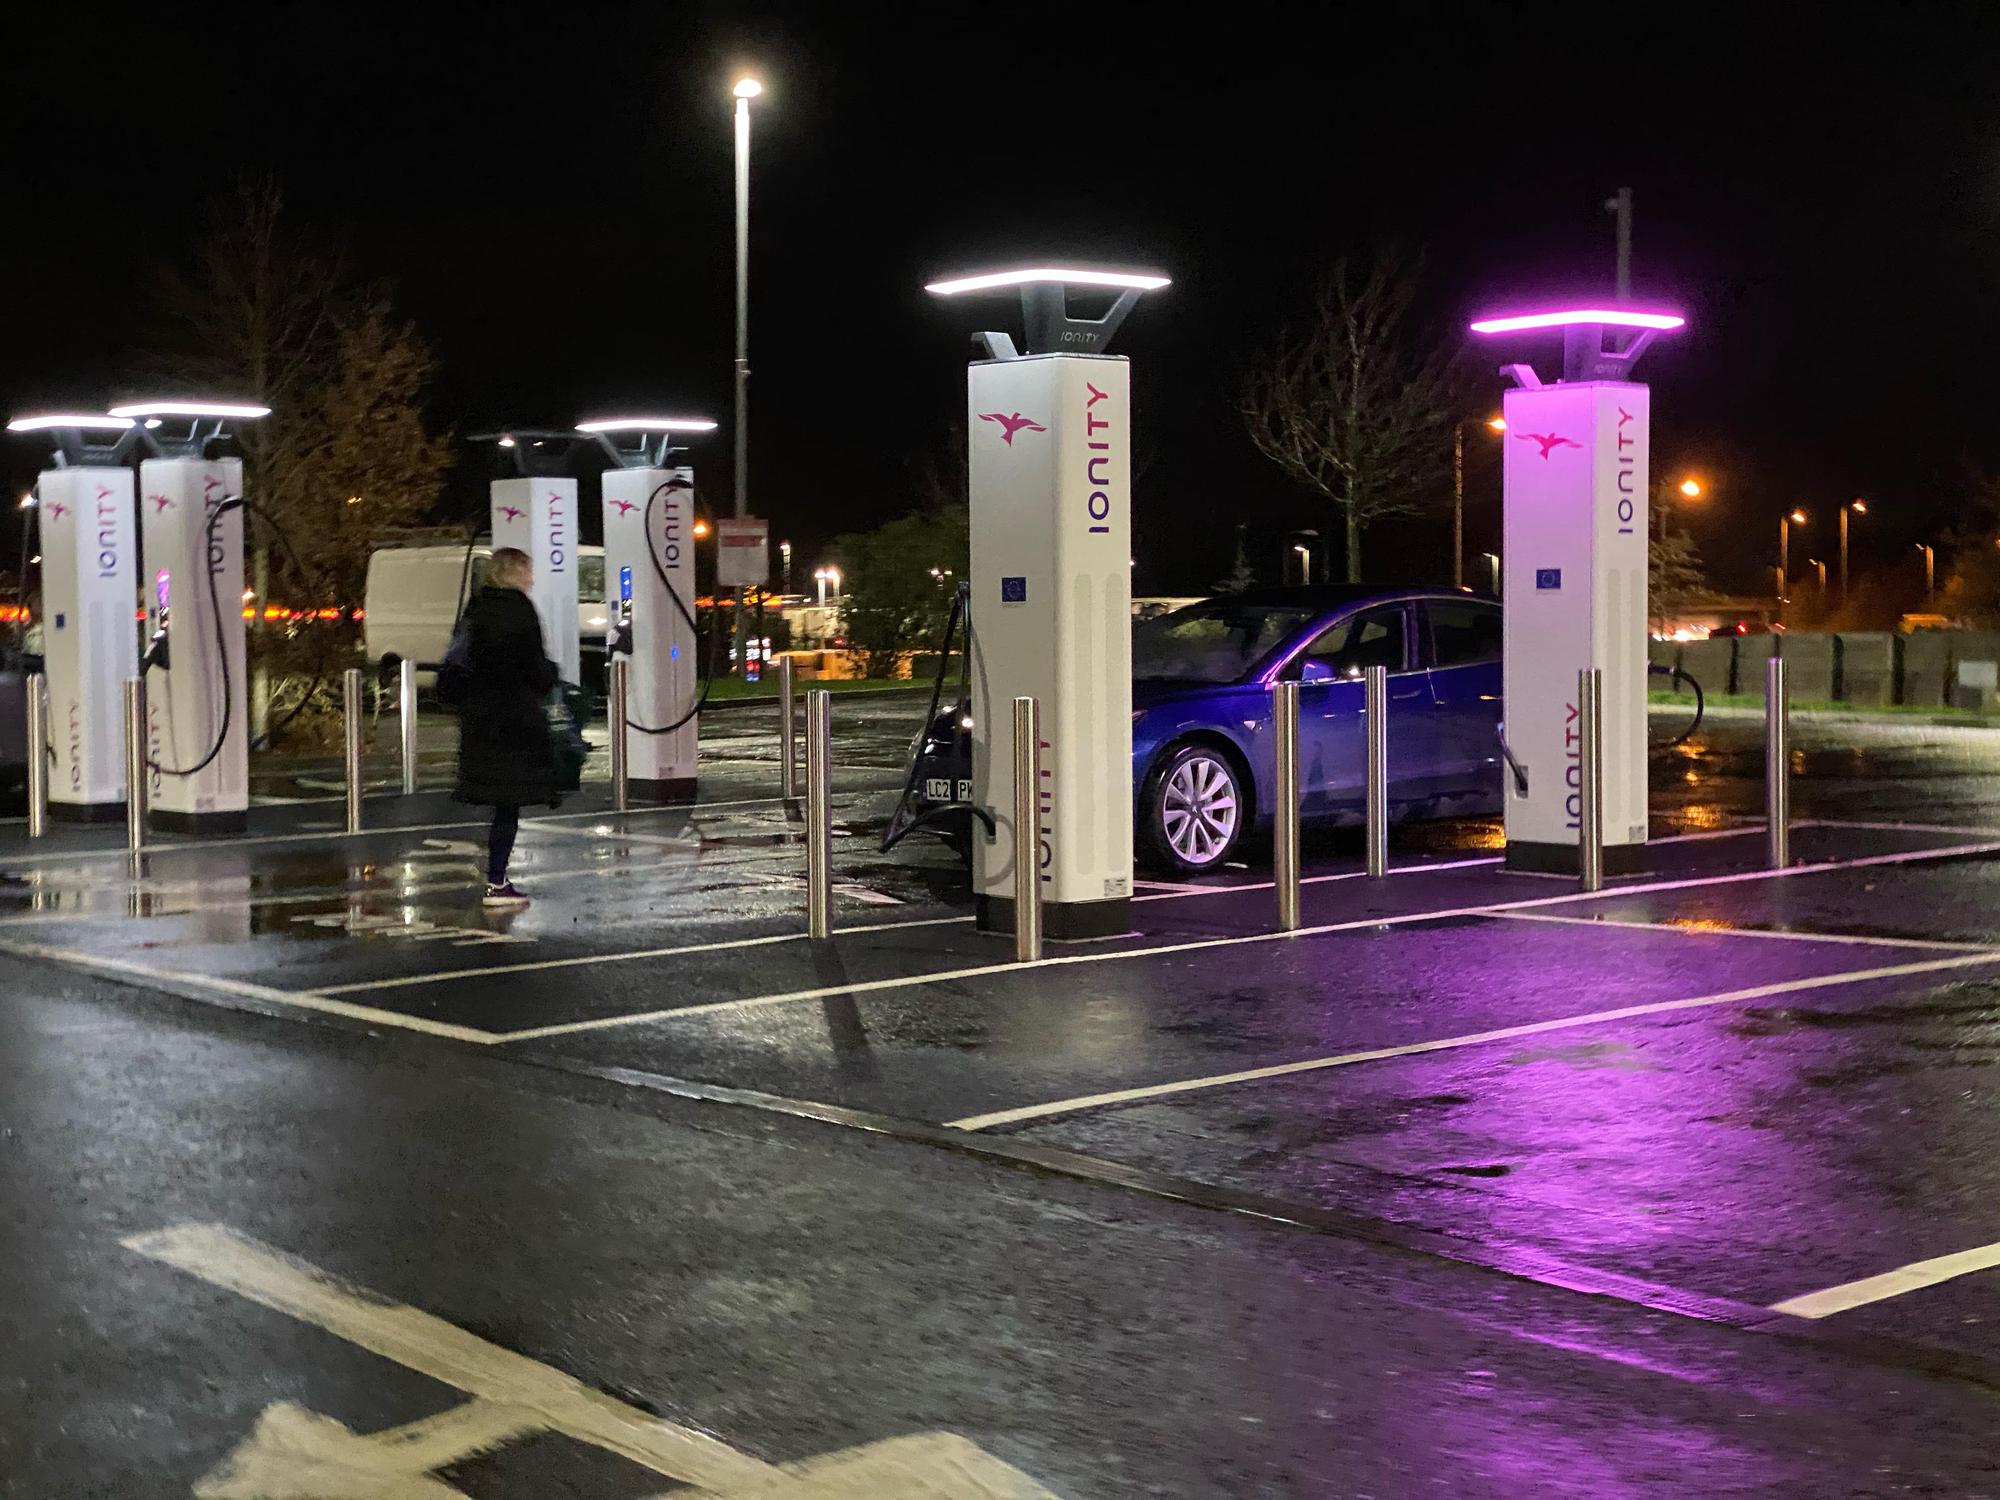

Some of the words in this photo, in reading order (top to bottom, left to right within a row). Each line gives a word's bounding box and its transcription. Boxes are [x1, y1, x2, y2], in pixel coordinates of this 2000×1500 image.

[1087, 382, 1109, 533] IONITY
[1618, 406, 1634, 534] IONITY
[97, 483, 117, 578] IONITY
[550, 490, 564, 572] IONITY
[665, 486, 680, 569] IONITY
[928, 780, 951, 798] LC2
